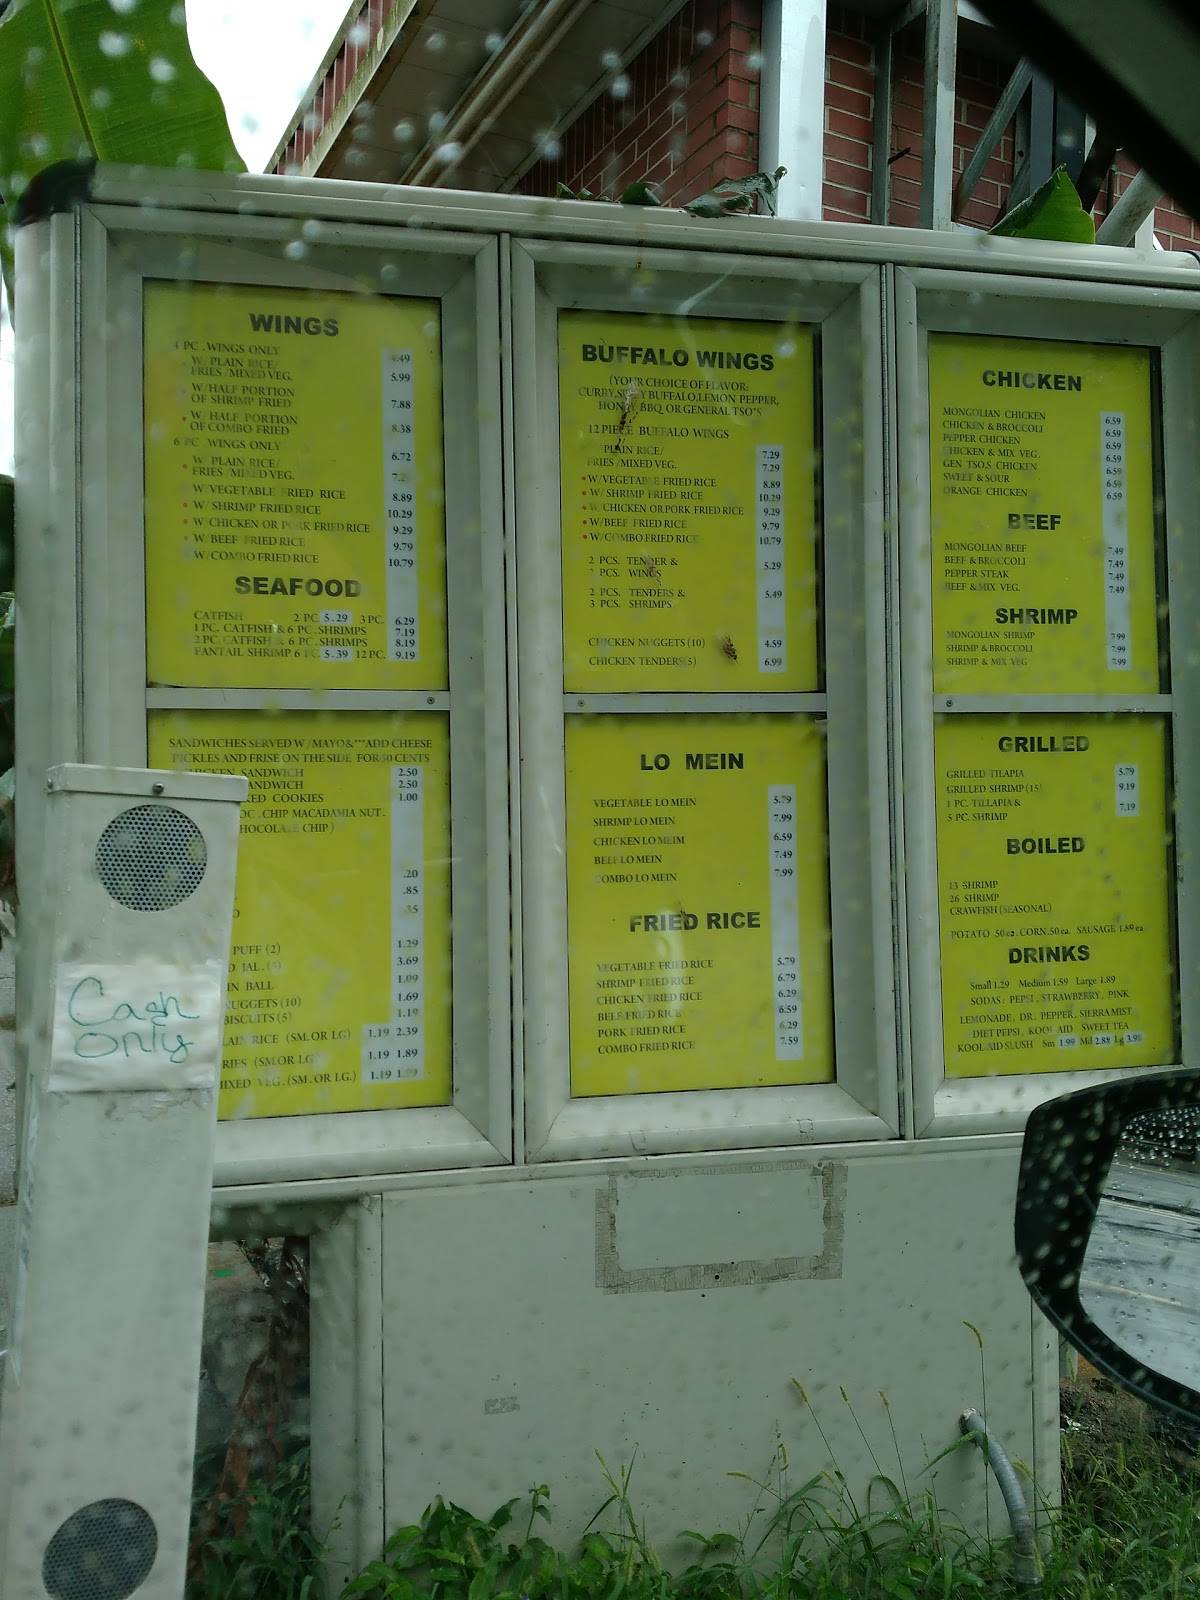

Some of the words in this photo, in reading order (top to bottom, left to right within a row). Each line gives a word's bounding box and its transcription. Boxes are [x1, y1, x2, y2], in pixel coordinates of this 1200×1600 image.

[249, 313, 339, 336] WINGS
[207, 342, 244, 353] WINGS
[249, 345, 280, 355] ONLY
[210, 357, 243, 367] PLAIN
[582, 344, 689, 367] BUFFALO
[696, 351, 775, 371] WINGS
[391, 373, 411, 382] 5.99
[983, 370, 1082, 391] CHICKEN
[391, 400, 411, 409] 7.88
[943, 407, 1000, 417] MONGOLIAN
[1005, 411, 1046, 420] CHICKEN
[392, 424, 411, 433] 8.38
[943, 434, 976, 442] PEPPER
[979, 435, 1020, 444] CHICKEN
[208, 439, 245, 449] WINGS
[250, 441, 281, 450] ONLY
[211, 456, 245, 466] PLAIN
[392, 452, 411, 461] 6.72
[654, 460, 677, 469] VEG.
[763, 464, 780, 472] 7.29
[996, 462, 1037, 470] CHICKEN
[193, 467, 223, 477] FRIES
[663, 477, 691, 486] FRIED
[694, 478, 717, 487] RICE
[763, 480, 780, 488] 8.89
[320, 490, 346, 499] RICE
[392, 493, 412, 502] 8.89
[606, 489, 644, 498] SHRIMP
[649, 491, 676, 499] FRIED
[681, 491, 703, 500] RICE
[759, 494, 781, 502] 10.29
[212, 501, 256, 512] SHRIMP
[260, 503, 292, 513] FRIED
[295, 506, 320, 515] RICE
[603, 504, 646, 513] CHICKEN
[650, 505, 662, 513] OR
[665, 505, 690, 514] PORK
[694, 506, 720, 514] FRIED
[722, 506, 744, 515] RICE
[764, 508, 780, 516] 9.29
[388, 509, 412, 519] 10.29
[209, 518, 258, 529] CHICKEN
[263, 520, 277, 529] OR
[664, 520, 687, 528] RICE
[762, 523, 779, 531] 9.79
[1008, 513, 1061, 530] BEEF
[314, 522, 345, 532] FRIED
[347, 523, 369, 533] RICE
[393, 526, 412, 535] 9.29
[211, 535, 237, 544] BEEF
[280, 537, 304, 546] RICE
[393, 542, 413, 551] 9.79
[944, 543, 1002, 551] MONGOLIAN
[1005, 544, 1026, 552] BEEF
[211, 552, 254, 561] COMBO
[258, 553, 290, 563] FRIED
[292, 554, 319, 563] RICE
[389, 558, 413, 568] 10.79
[764, 562, 781, 570] 5.29
[980, 570, 1008, 578] STEAK
[235, 576, 361, 597] SEAFOOD
[996, 608, 1078, 624] SHRIMP
[319, 625, 366, 635] SHRIMPS
[396, 627, 415, 636] 7.19
[1004, 631, 1035, 639] SHRIMP
[320, 637, 367, 647] SHRIMPS
[396, 638, 415, 647] 8.19
[248, 648, 291, 657] SHRIMP
[294, 649, 300, 657] 6
[989, 644, 1033, 652] BROCCOLI
[589, 657, 635, 665] CHICKEN
[765, 658, 782, 666] 6.99
[169, 739, 246, 748] SANDWICHES
[249, 739, 291, 748] SERVED
[392, 739, 432, 748] CHEESE
[998, 736, 1089, 752] GRILLED
[357, 754, 379, 763] FOR
[395, 754, 429, 763] CENTS
[641, 754, 670, 770] LO
[686, 753, 744, 770] MEIN
[399, 780, 417, 789] 2.50
[272, 794, 324, 803] COOKIES
[399, 792, 417, 801] 1.00
[594, 799, 652, 808] VEGETABLE
[671, 798, 696, 806] MEIN
[774, 796, 791, 804] 5.79
[593, 818, 632, 826] SHRIMP
[650, 817, 675, 825] MEIN
[774, 814, 792, 822] 7.99
[594, 838, 640, 846] CHICKEN
[643, 837, 655, 845] LO
[1007, 837, 1085, 854] BOILED
[637, 855, 662, 863] MEIN
[774, 851, 792, 859] 7.49
[403, 870, 418, 878] .20
[635, 874, 649, 882] LO
[652, 873, 677, 881] MEIN
[775, 868, 793, 876] 7.99
[403, 887, 418, 895] .85
[629, 913, 698, 932] FRIED
[707, 912, 760, 929] RICE
[1020, 928, 1045, 936] CORN
[1077, 925, 1115, 933] SAUSAGE
[951, 930, 990, 939] POTATO
[1009, 945, 1090, 964] DRINKS
[398, 956, 418, 965] 3.69
[690, 960, 713, 968] RICE
[778, 973, 796, 981] 6.79
[246, 980, 273, 991] BALL
[398, 975, 418, 983] 1.09
[597, 979, 635, 988] SHRIMP
[971, 980, 991, 990] Small
[994, 981, 1009, 989] 1.29
[1019, 979, 1051, 988] Medium
[1076, 977, 1097, 987] Large
[1100, 976, 1115, 984] 1.89
[679, 992, 702, 1000] RICE
[778, 989, 796, 997] 6.29
[1108, 990, 1130, 998] PINK
[69, 977, 200, 1027] Cash
[779, 1005, 797, 1013] 6.59
[368, 1029, 389, 1038] 1.19
[396, 1027, 417, 1036] 2.39
[598, 1028, 626, 1038] PORK
[662, 1025, 686, 1034] RICE
[1058, 1025, 1072, 1033] AID
[1082, 1023, 1110, 1031] SWEET
[973, 1029, 996, 1038] DIET
[253, 1034, 279, 1044] RICE
[598, 1044, 637, 1054] COMBO
[640, 1043, 669, 1051] FRIED
[672, 1041, 694, 1050] RICE
[780, 1037, 798, 1045] 7.59
[958, 1043, 983, 1052] KOOL
[368, 1050, 389, 1059] 1.19
[397, 1049, 417, 1058] 1.89
